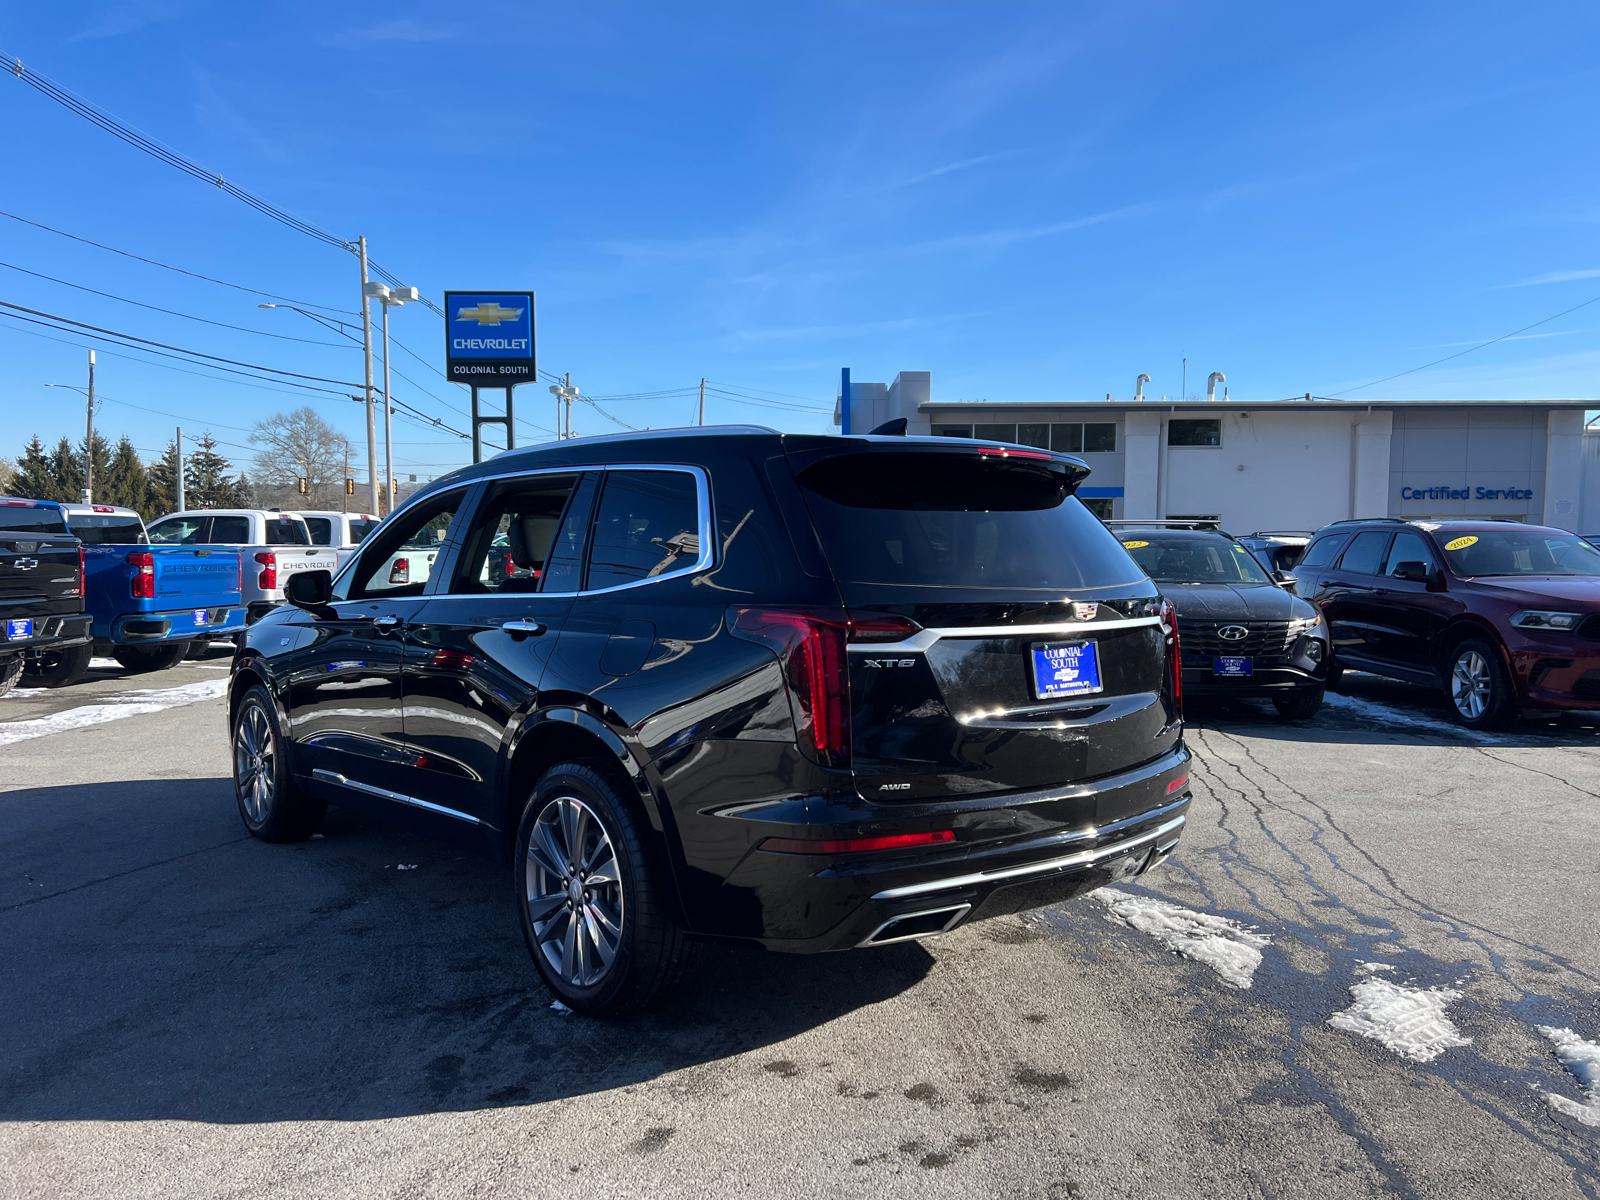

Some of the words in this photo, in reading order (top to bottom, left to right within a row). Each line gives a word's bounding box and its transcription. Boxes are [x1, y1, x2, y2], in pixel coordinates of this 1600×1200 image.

[453, 338, 527, 349] CHEVROLET
[453, 365, 497, 374] COLONIAL
[499, 365, 529, 374] SOUTH
[1401, 486, 1470, 500] Certified
[1475, 486, 1534, 500] Service
[1450, 537, 1473, 548] 2024
[163, 564, 237, 573] CHEVROLET
[283, 562, 335, 570] CHEVROLET
[1044, 646, 1083, 659] COLONIAL
[863, 659, 916, 668] XT6
[1051, 657, 1079, 669] SOUTH
[879, 783, 911, 791] AWD
